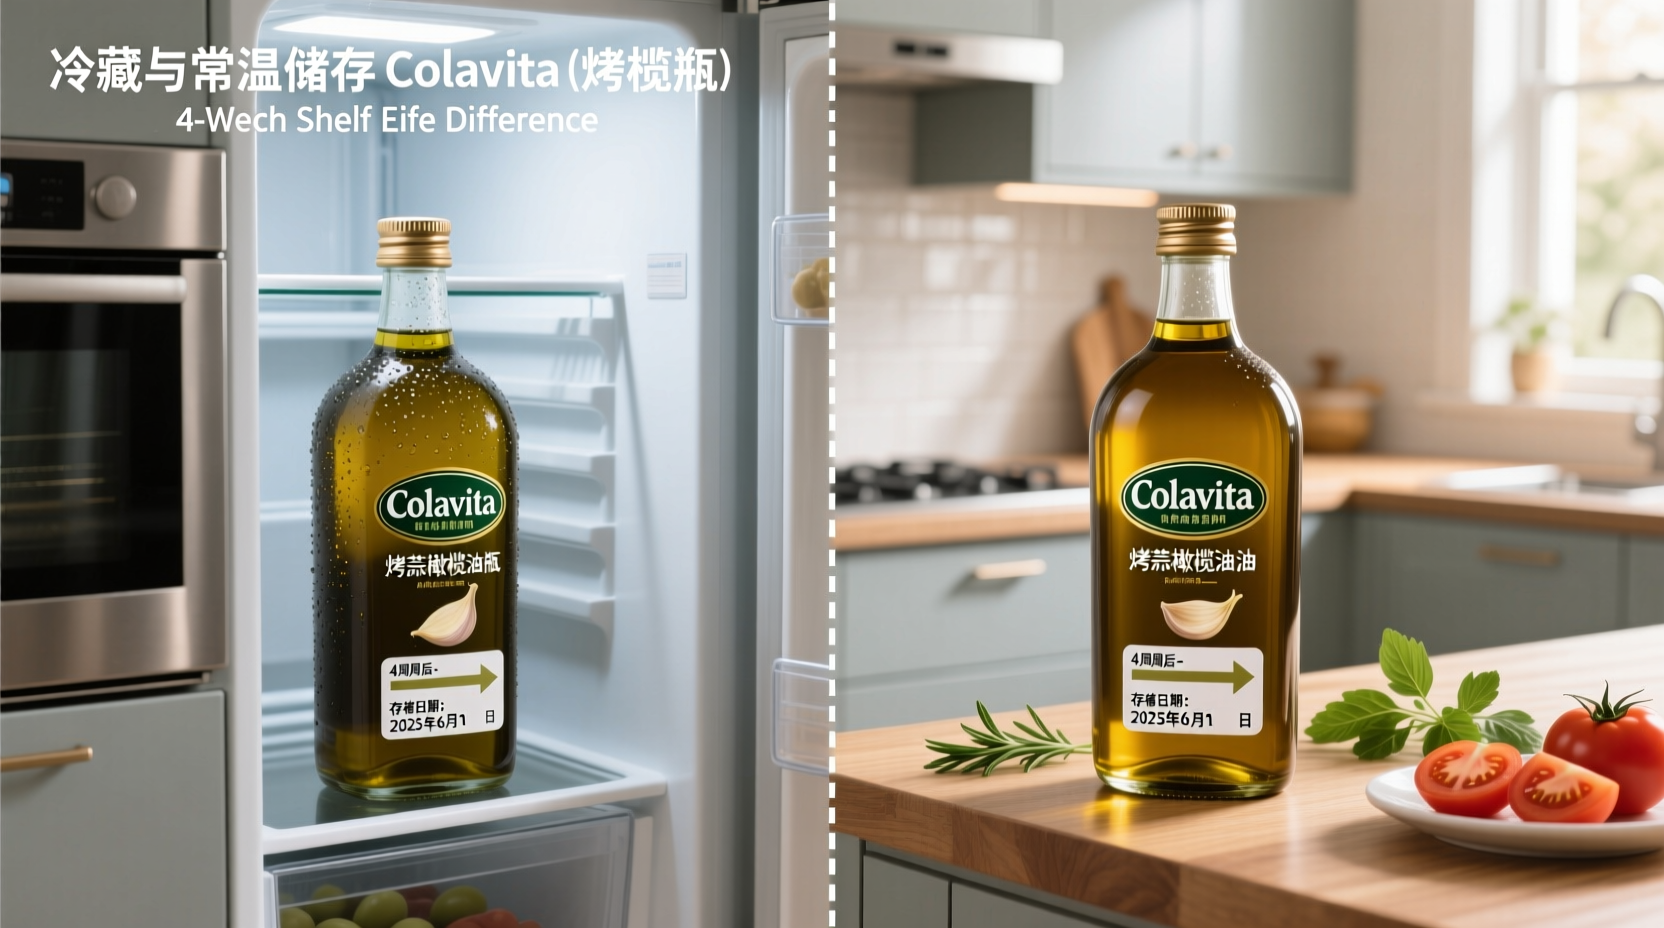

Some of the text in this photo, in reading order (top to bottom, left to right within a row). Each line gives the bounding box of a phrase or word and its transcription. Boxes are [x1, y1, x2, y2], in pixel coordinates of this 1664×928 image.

[386, 487, 497, 519] Colavita
[1131, 477, 1255, 511] Colavita
[485, 709, 495, 724] 日
[1130, 711, 1251, 728] 2025年6月1 日
